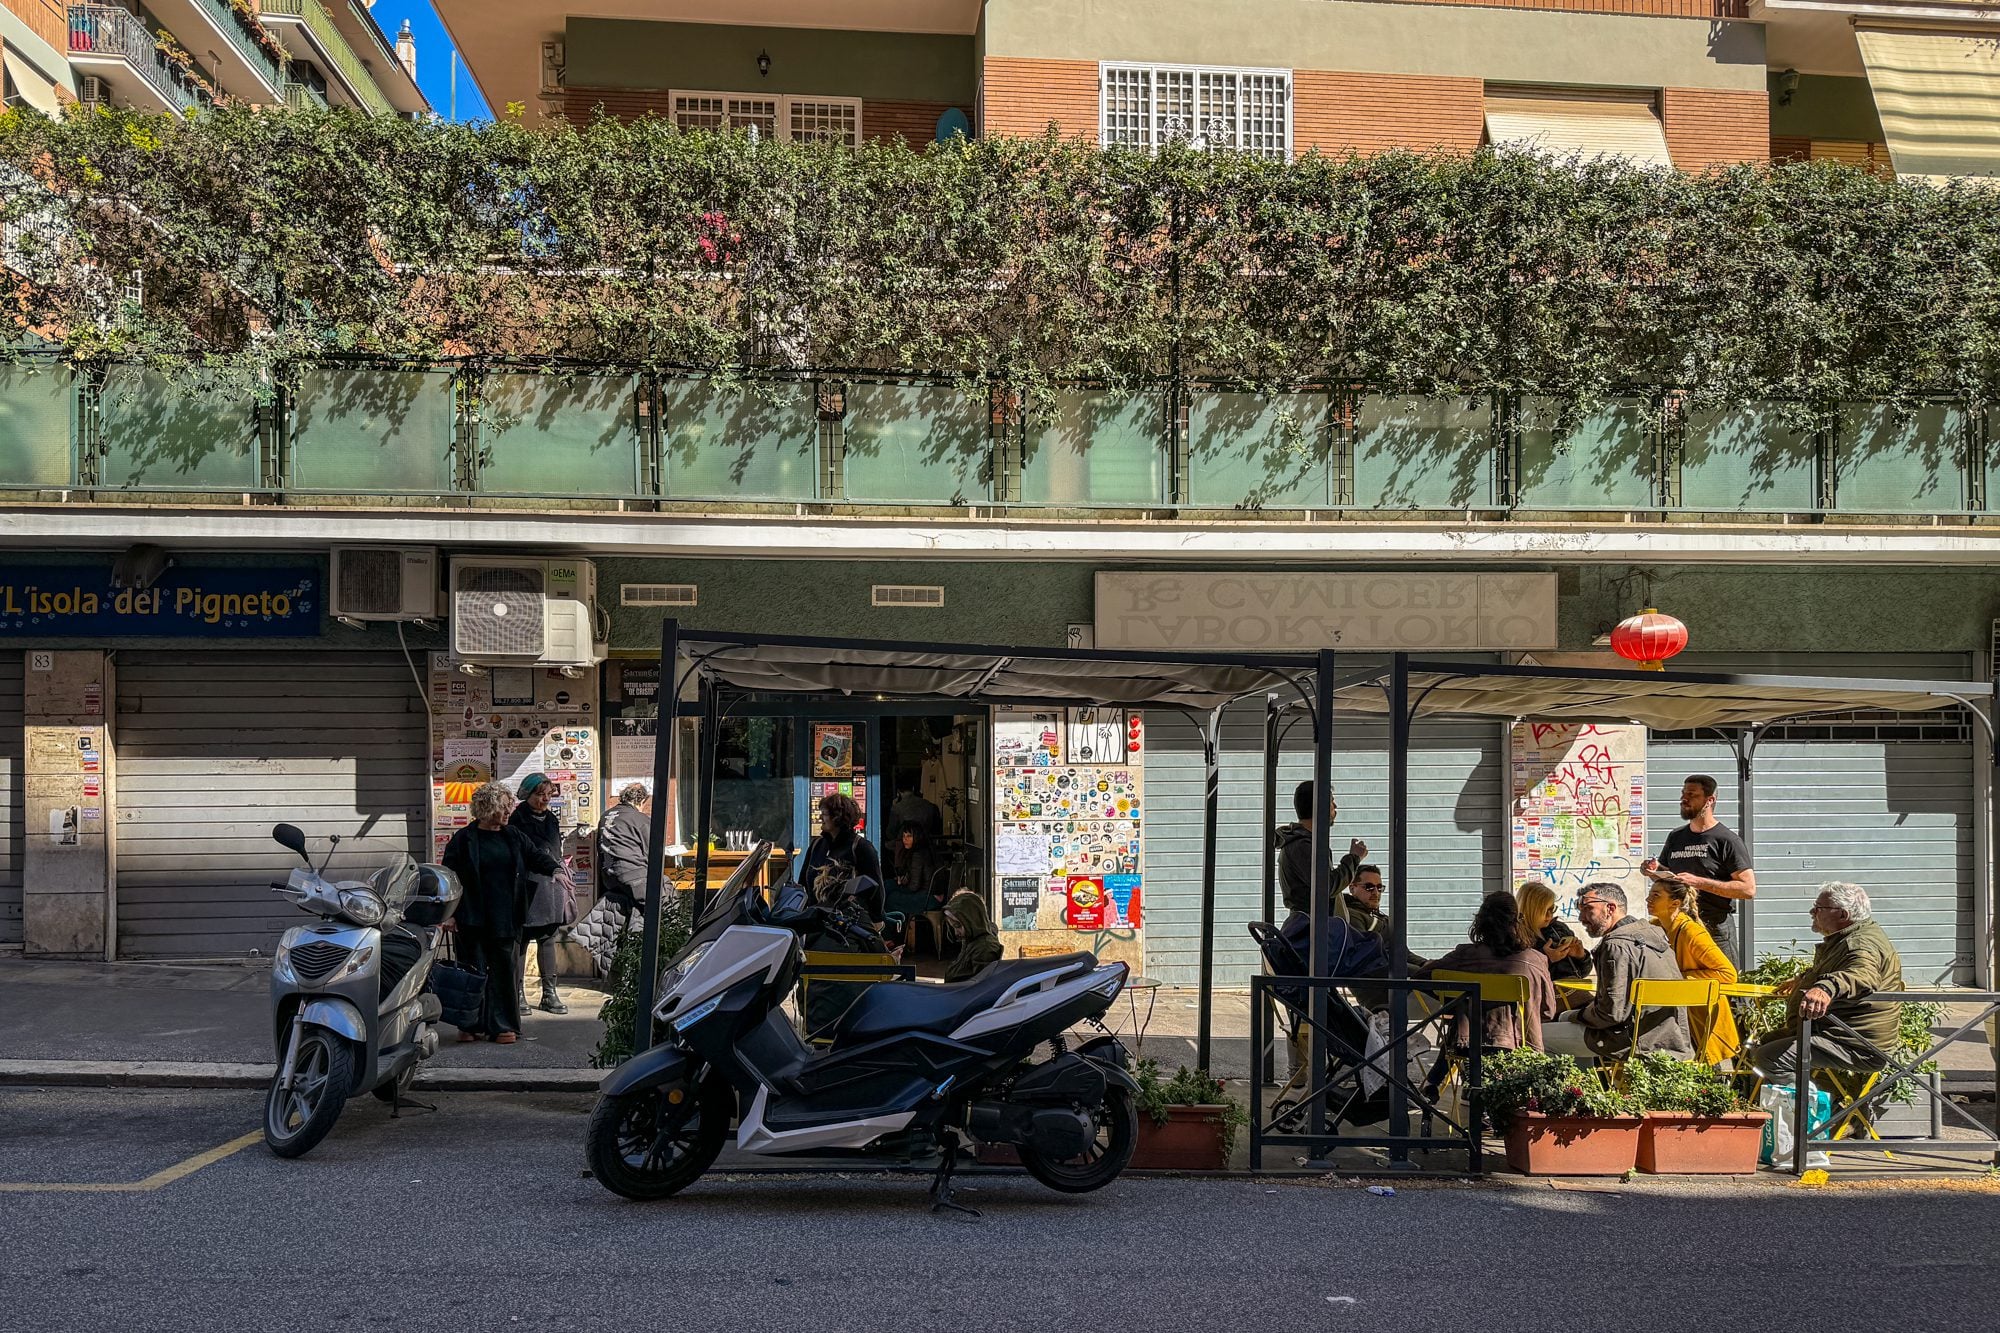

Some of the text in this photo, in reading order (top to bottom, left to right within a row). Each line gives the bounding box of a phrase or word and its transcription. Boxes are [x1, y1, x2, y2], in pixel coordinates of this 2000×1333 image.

[114, 588, 160, 615] del
[34, 654, 51, 669] 83
[436, 656, 450, 668] 85
[1765, 1118, 1773, 1147] TIGOT
